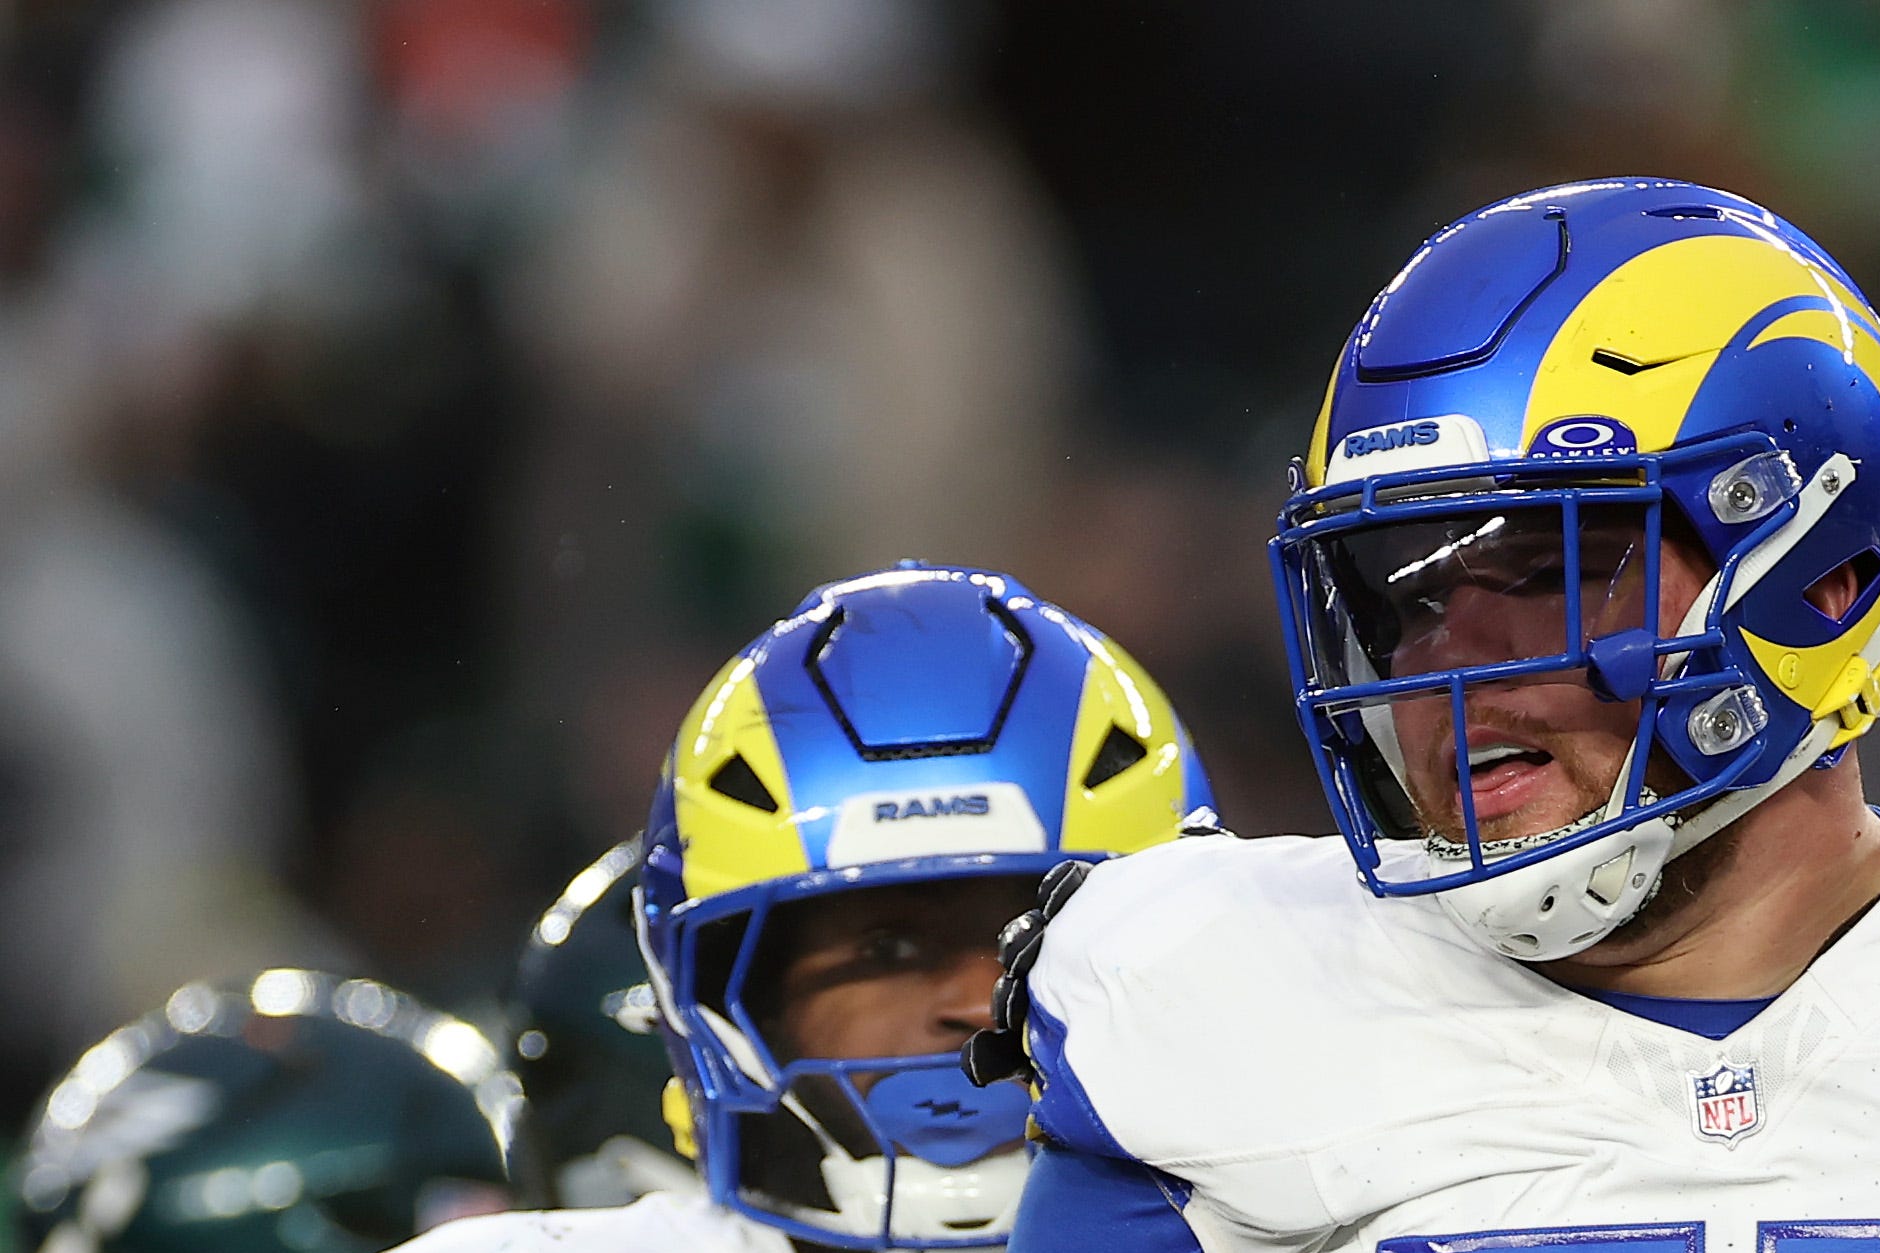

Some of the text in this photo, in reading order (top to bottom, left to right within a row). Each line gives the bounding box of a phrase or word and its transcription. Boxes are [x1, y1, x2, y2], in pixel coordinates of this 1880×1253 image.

[1344, 421, 1440, 459] RAMS
[874, 795, 990, 823] RAMS
[1702, 1095, 1754, 1131] NFL
